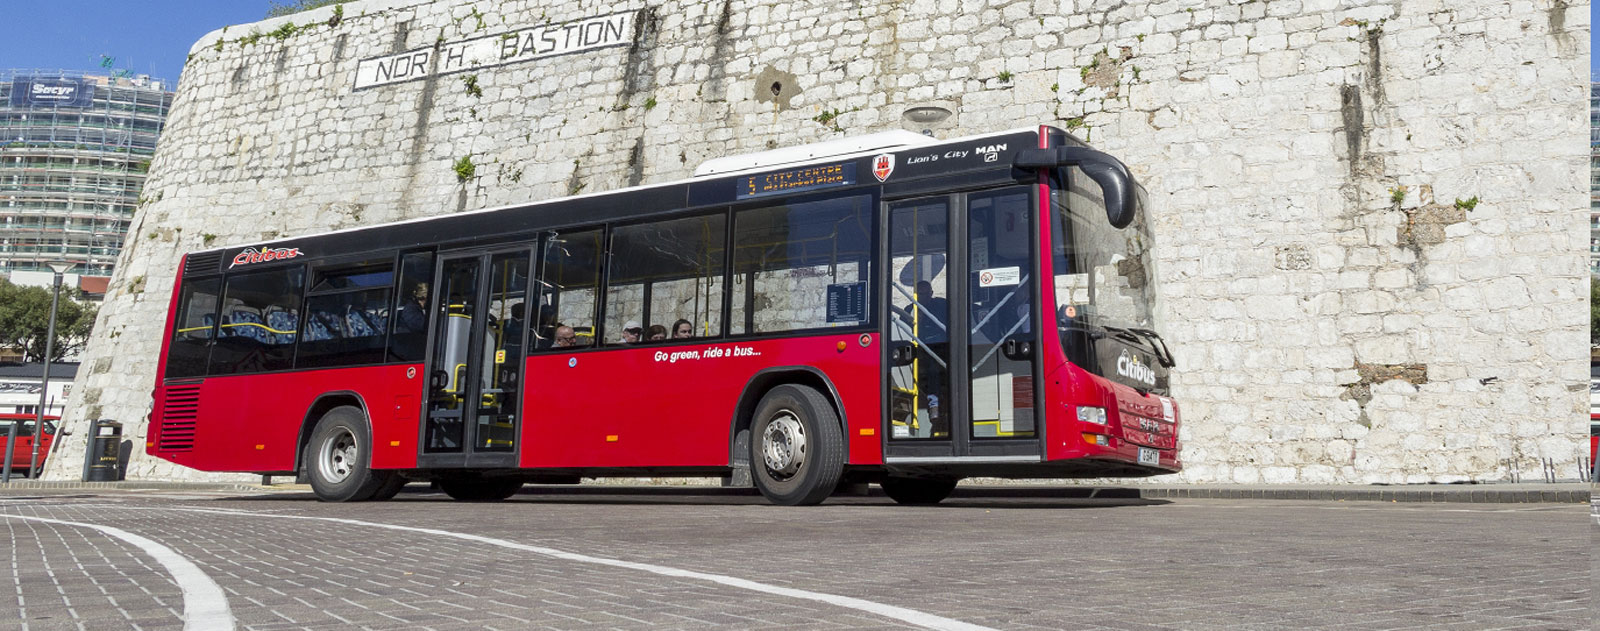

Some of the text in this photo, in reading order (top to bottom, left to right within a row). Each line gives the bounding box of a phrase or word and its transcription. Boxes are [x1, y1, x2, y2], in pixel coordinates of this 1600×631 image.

[500, 17, 625, 60] BASTION
[31, 83, 75, 95] Sacyr
[907, 143, 1008, 165] Lion's City MAN
[765, 164, 843, 184] CITY CENTRE
[748, 176, 756, 195] 5
[233, 246, 300, 265] Citibus
[654, 345, 762, 363] Go green, ride a bus...
[1117, 354, 1156, 385] Citibus
